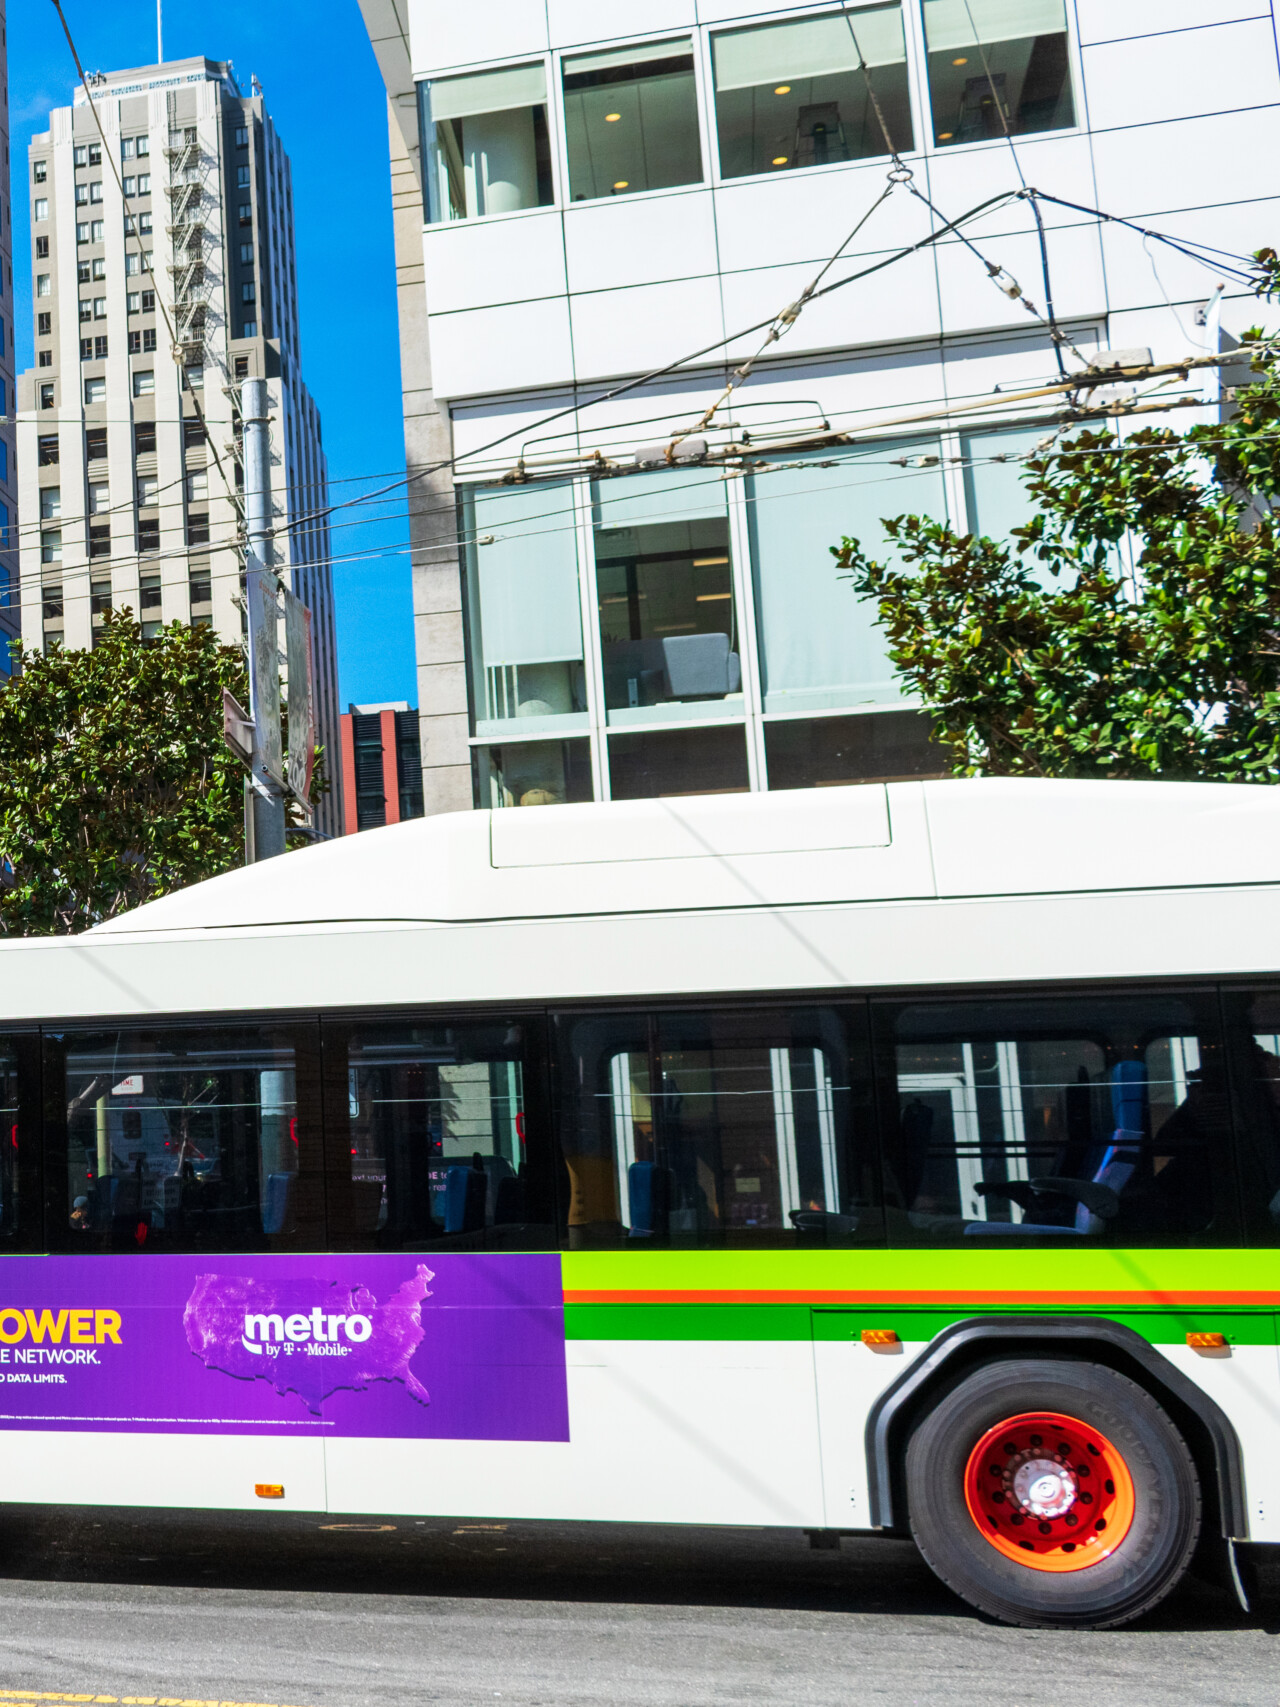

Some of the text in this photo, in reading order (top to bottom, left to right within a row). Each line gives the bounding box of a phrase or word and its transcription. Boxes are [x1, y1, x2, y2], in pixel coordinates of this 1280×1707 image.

[242, 1307, 373, 1342] metro
[14, 1349, 101, 1365] NETWORK.
[265, 1342, 281, 1359] by
[6, 1374, 32, 1383] DATA
[34, 1374, 68, 1384] LIMITS.
